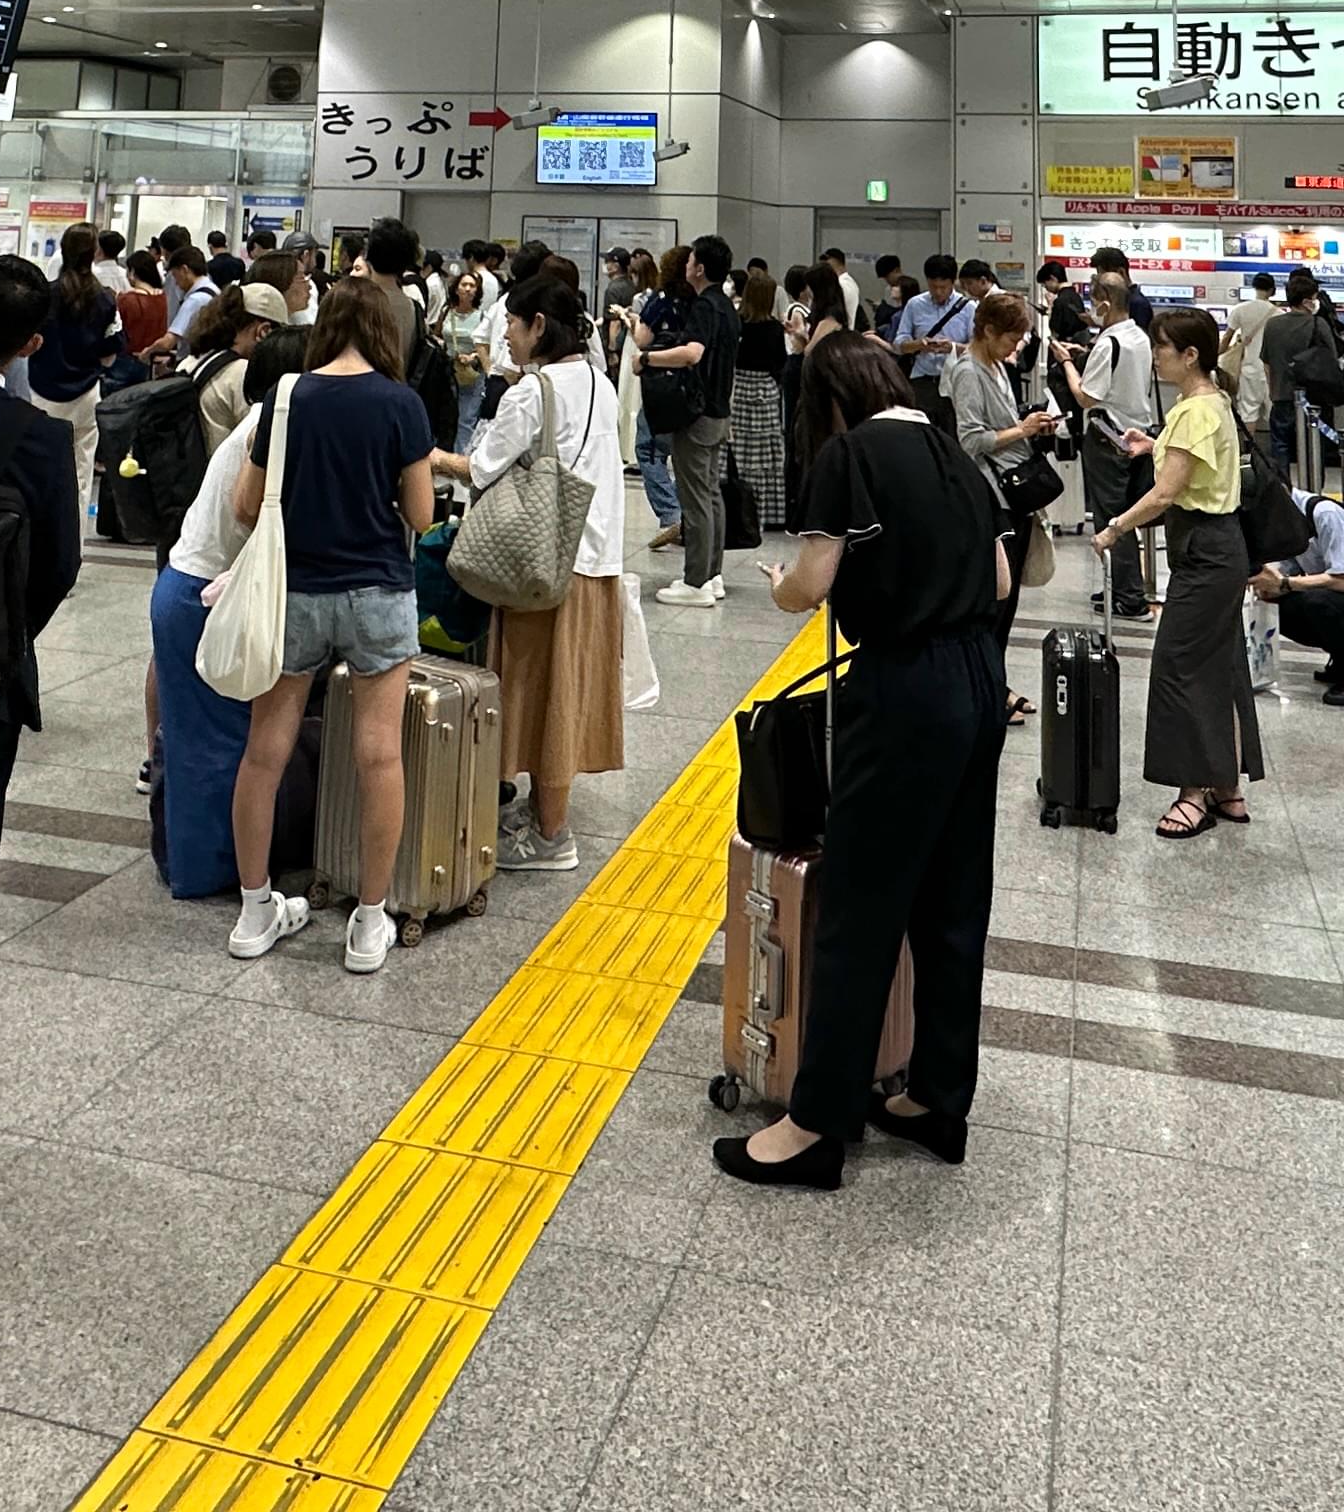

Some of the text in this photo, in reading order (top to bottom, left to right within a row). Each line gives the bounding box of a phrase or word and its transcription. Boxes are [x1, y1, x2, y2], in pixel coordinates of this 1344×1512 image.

[1136, 85, 1320, 110] Skansen
[321, 101, 454, 136] きっぷ
[345, 145, 490, 180] うりば
[1124, 203, 1197, 216] Apple Pay
